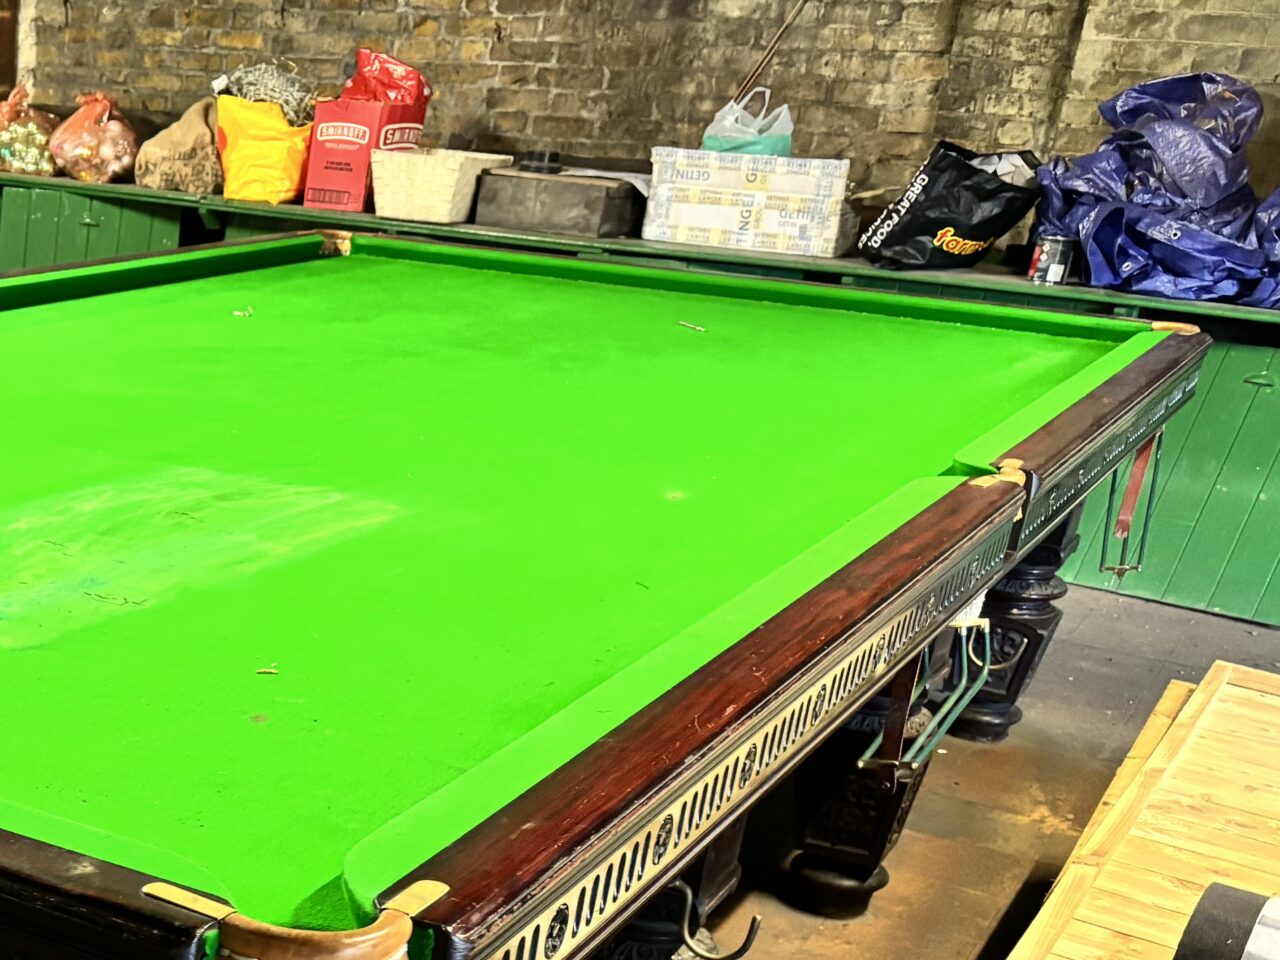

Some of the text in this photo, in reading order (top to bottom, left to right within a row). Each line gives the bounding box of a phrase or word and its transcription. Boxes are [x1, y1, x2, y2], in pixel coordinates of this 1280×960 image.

[320, 126, 365, 140] SMIRNOFF
[898, 173, 929, 217] GREAT
[867, 212, 900, 249] FOOD,
